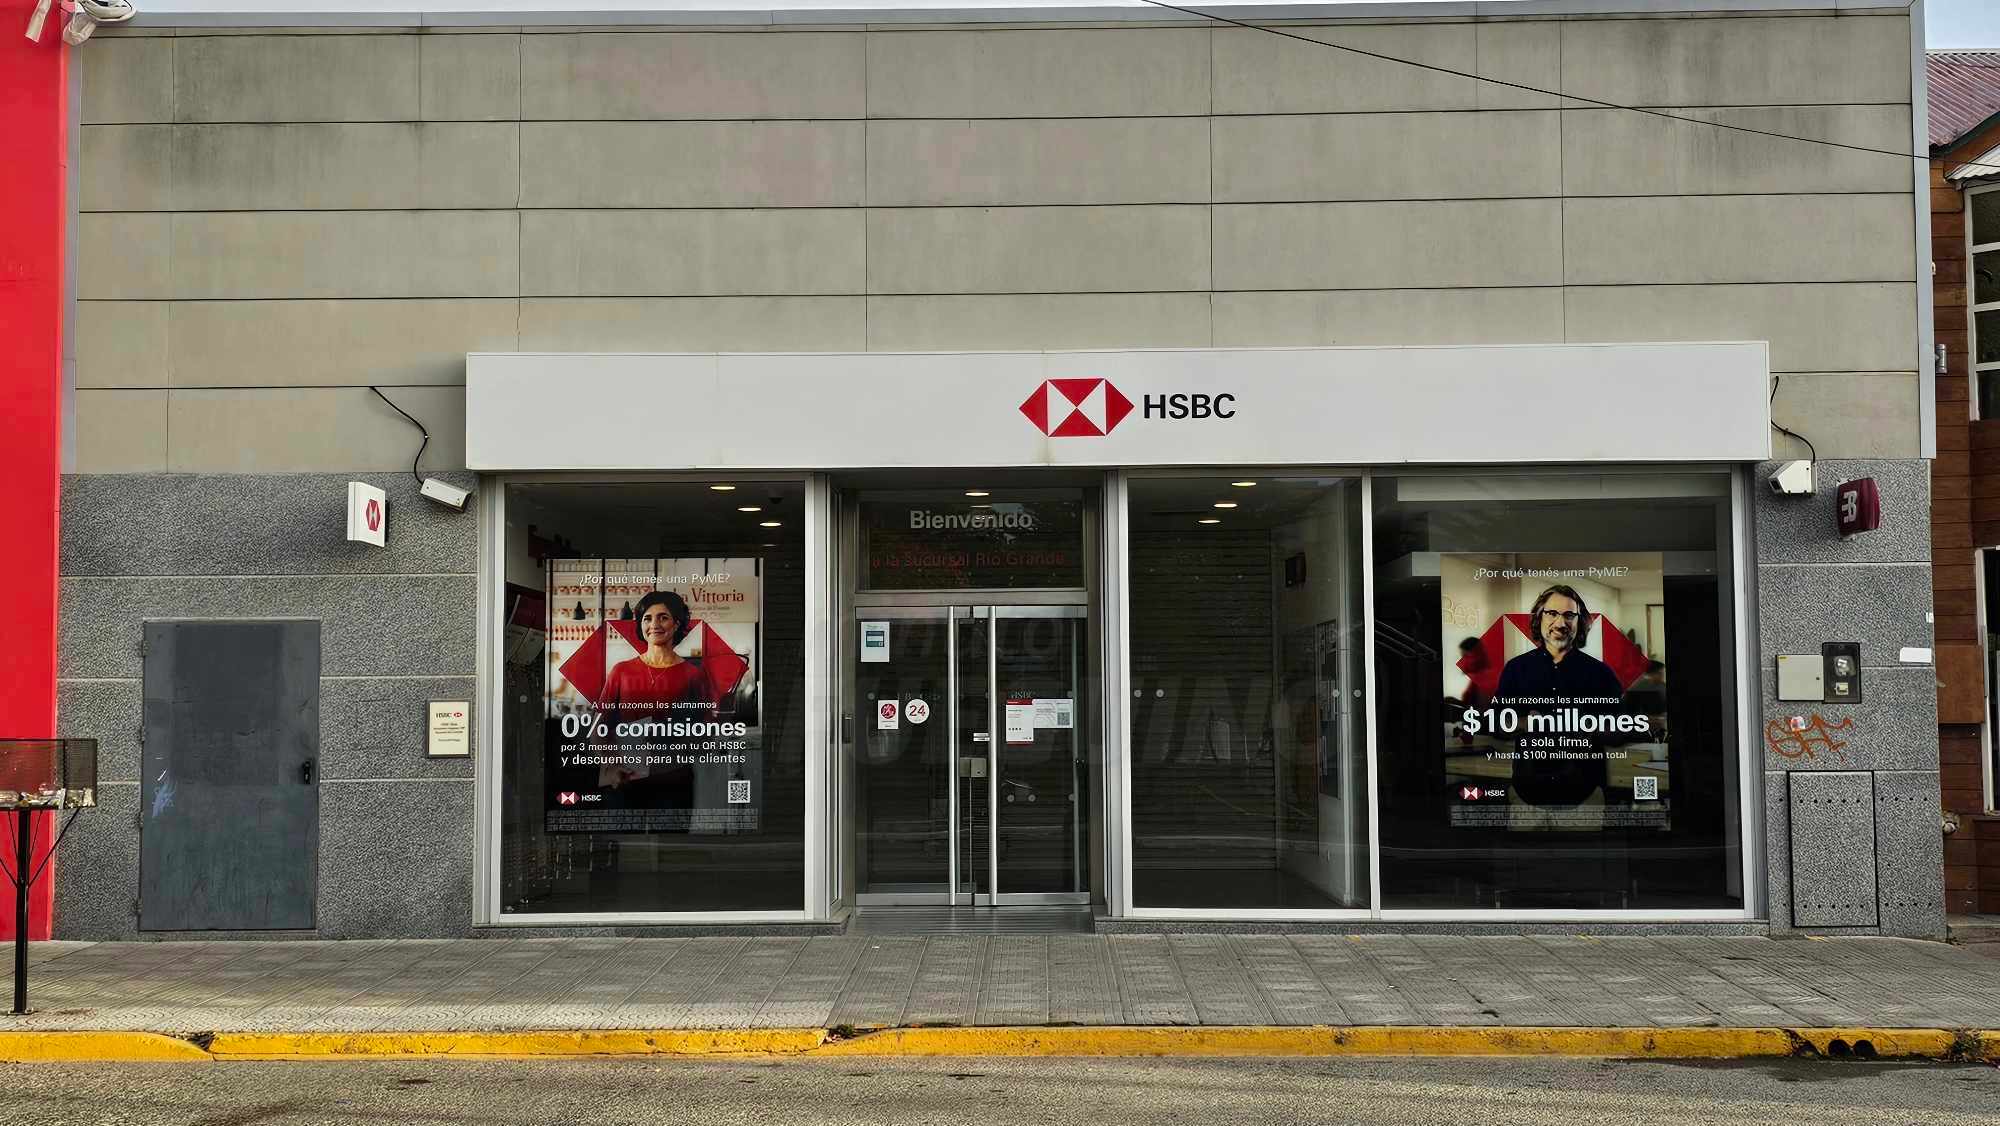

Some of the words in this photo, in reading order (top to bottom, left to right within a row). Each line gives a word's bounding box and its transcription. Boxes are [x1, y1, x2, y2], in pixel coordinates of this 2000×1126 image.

[1143, 393, 1236, 419] HSBC
[910, 509, 1033, 529] Bienvenido
[903, 553, 969, 568] Sucursal
[1005, 551, 1066, 566] Grande
[579, 574, 603, 587] ¿Por
[607, 573, 628, 586] qué
[666, 576, 687, 584] una
[691, 573, 730, 586] PyME?
[1473, 567, 1499, 581] ¿Por
[1502, 567, 1524, 580] qué
[1563, 569, 1585, 578] una
[1588, 567, 1629, 579] PyME?
[691, 587, 744, 603] Vittoria
[591, 701, 598, 709] A
[1491, 696, 1498, 704] A
[909, 704, 926, 717] 24
[561, 713, 609, 738] 0%
[615, 718, 746, 737] comisiones
[1463, 706, 1518, 736] $10
[1527, 708, 1650, 733] millones
[561, 743, 577, 752] por
[579, 742, 585, 751] 3
[588, 743, 618, 751] meses
[635, 742, 667, 751] cobros
[690, 742, 700, 750] tu
[702, 741, 716, 750] QR
[719, 741, 746, 750] HSBC
[1520, 738, 1527, 747] a
[1531, 736, 1555, 747] sola
[1558, 736, 1593, 748] firma,
[561, 756, 568, 766] y
[572, 754, 642, 765] descuentos
[646, 756, 672, 766] para
[676, 754, 694, 764] tus
[699, 753, 746, 764] clientes
[1486, 752, 1492, 760] y
[1494, 751, 1521, 760] hasta
[1523, 750, 1547, 761] $100
[1549, 751, 1589, 760] millones
[1606, 751, 1627, 760] total
[581, 794, 602, 802] HSBC
